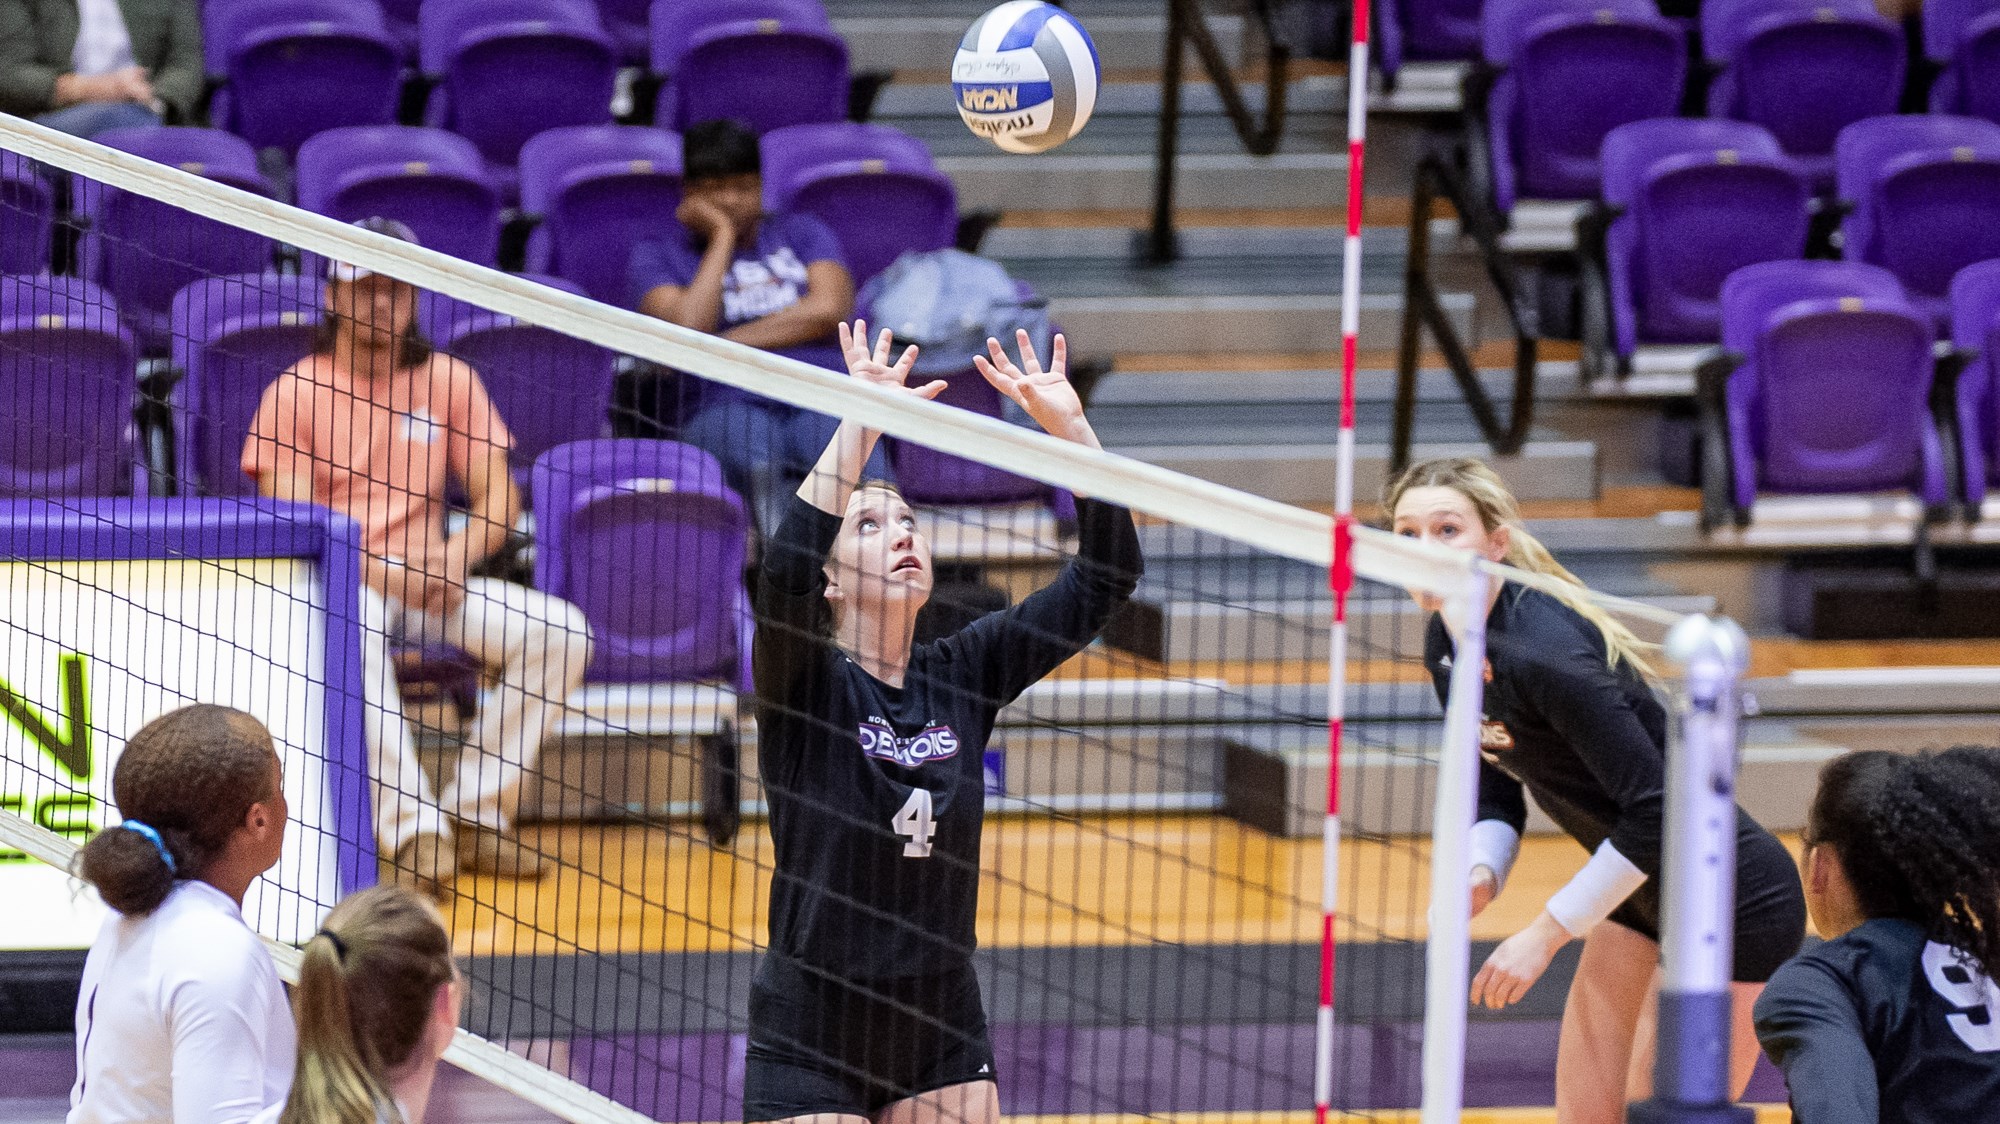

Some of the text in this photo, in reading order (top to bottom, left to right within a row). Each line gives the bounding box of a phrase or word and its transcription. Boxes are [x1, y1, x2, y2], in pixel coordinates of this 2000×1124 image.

[962, 84, 1018, 111] NCAA
[859, 727, 958, 764] DEMONS
[891, 787, 937, 857] 4
[1921, 939, 2000, 1053] 9
